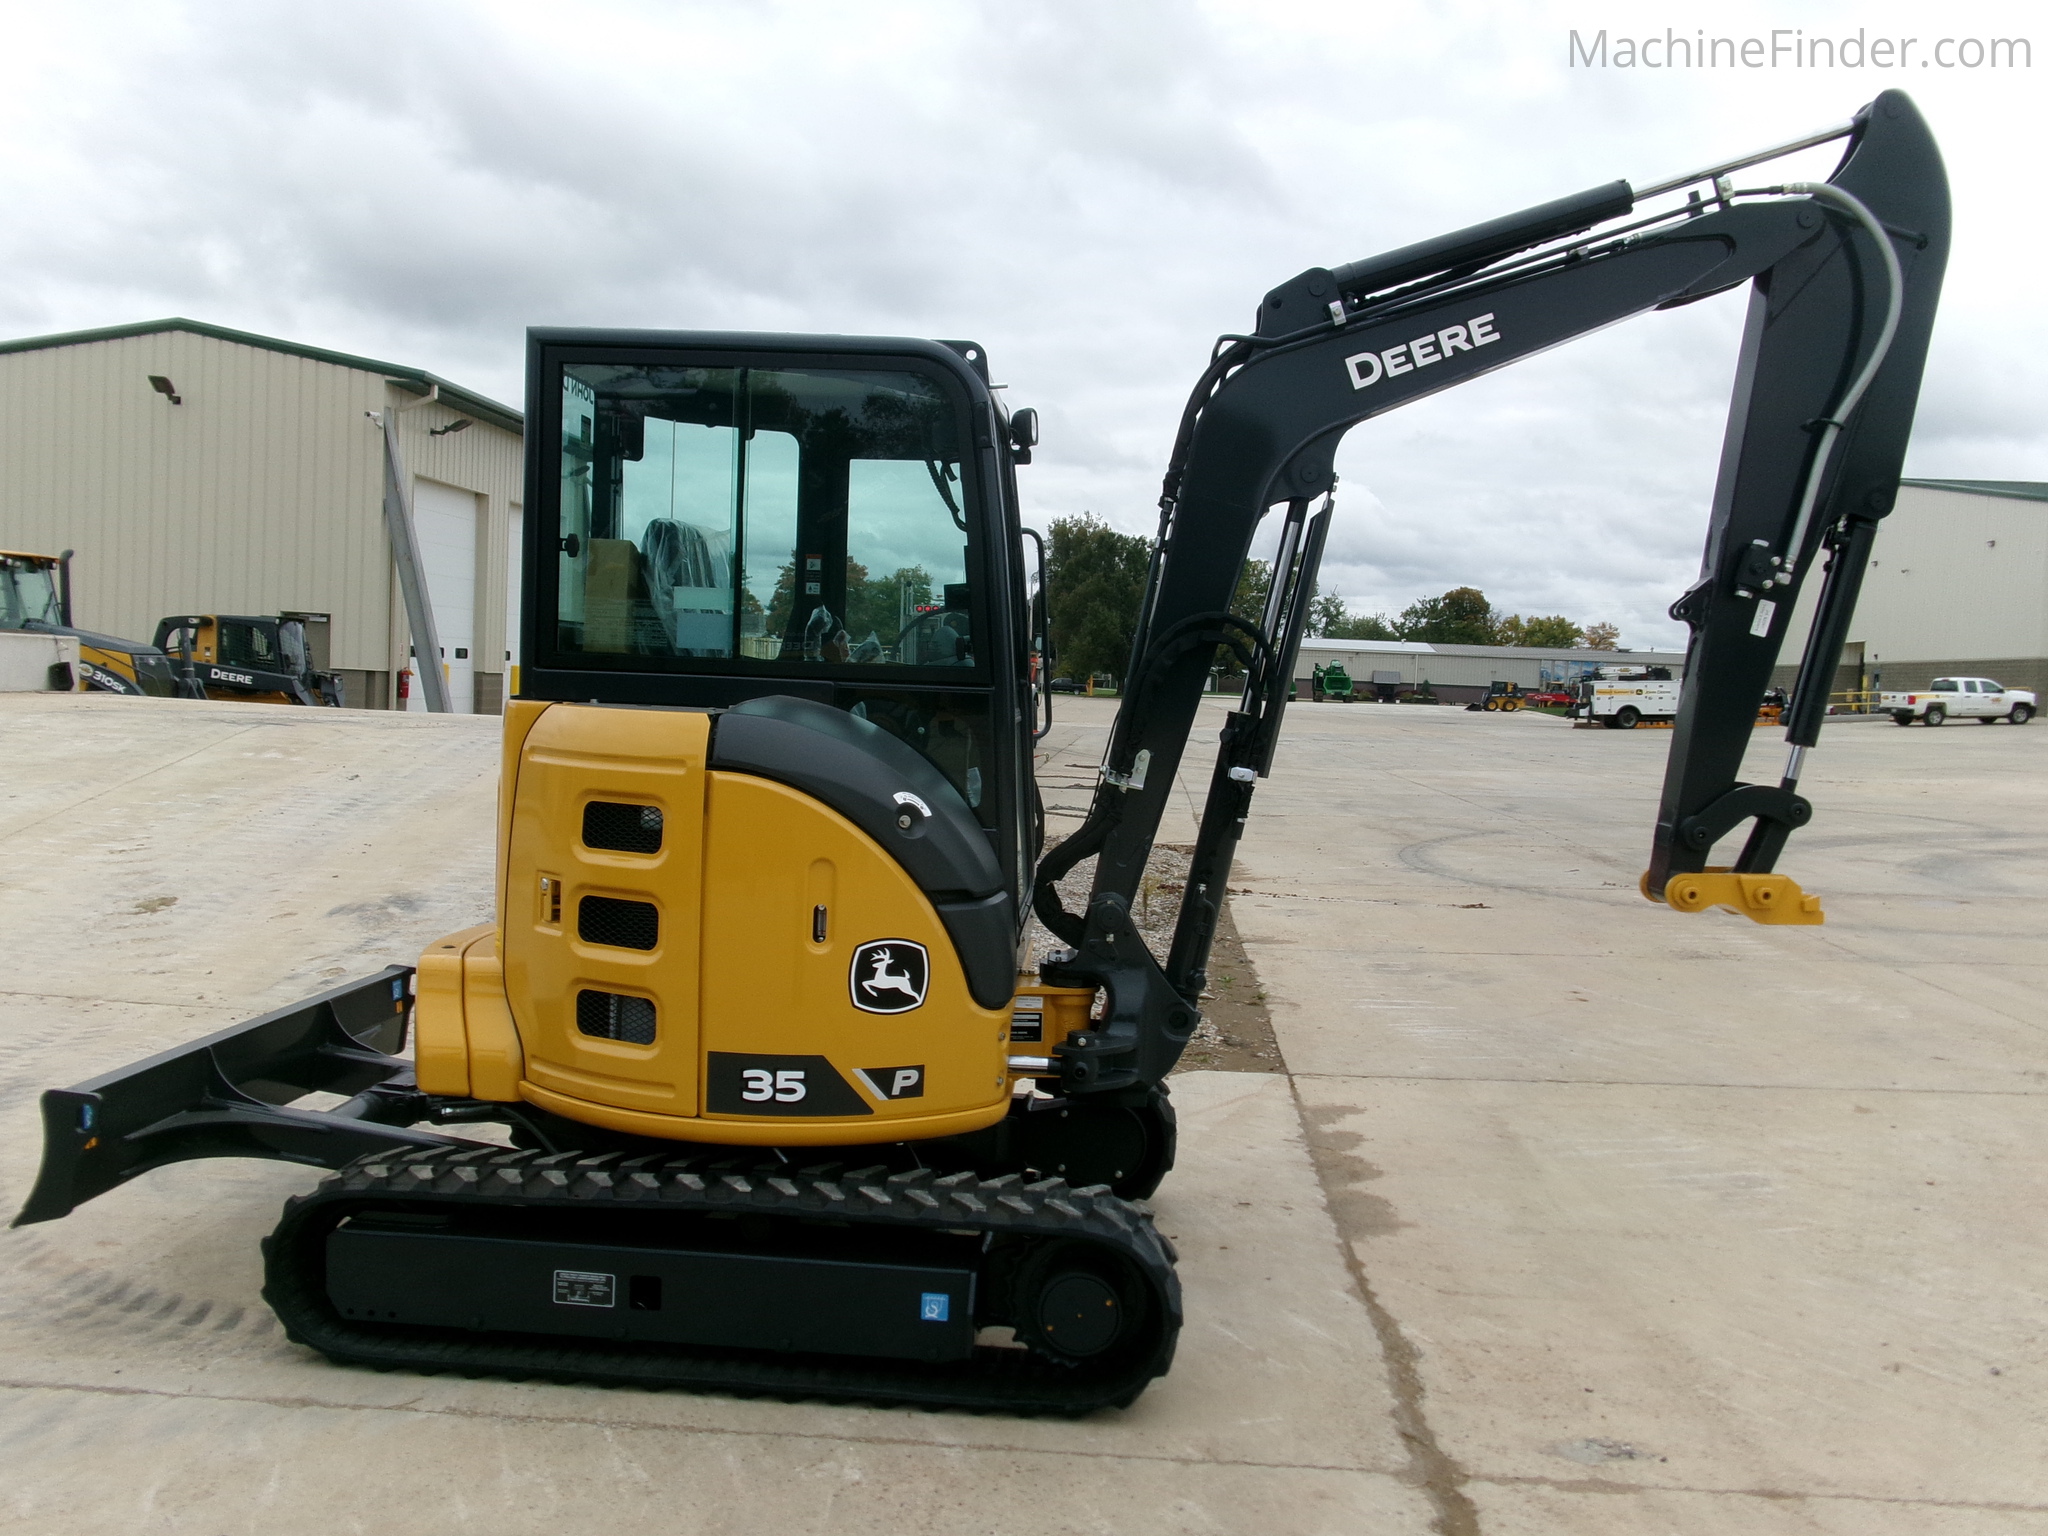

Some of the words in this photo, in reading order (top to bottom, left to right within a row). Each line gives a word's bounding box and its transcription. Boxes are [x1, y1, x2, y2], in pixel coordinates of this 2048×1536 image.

[1345, 312, 1500, 390] DEERE
[92, 670, 127, 694] 310SK
[210, 668, 253, 685] DEERE
[742, 1069, 806, 1102] 35
[891, 1069, 919, 1096] P
